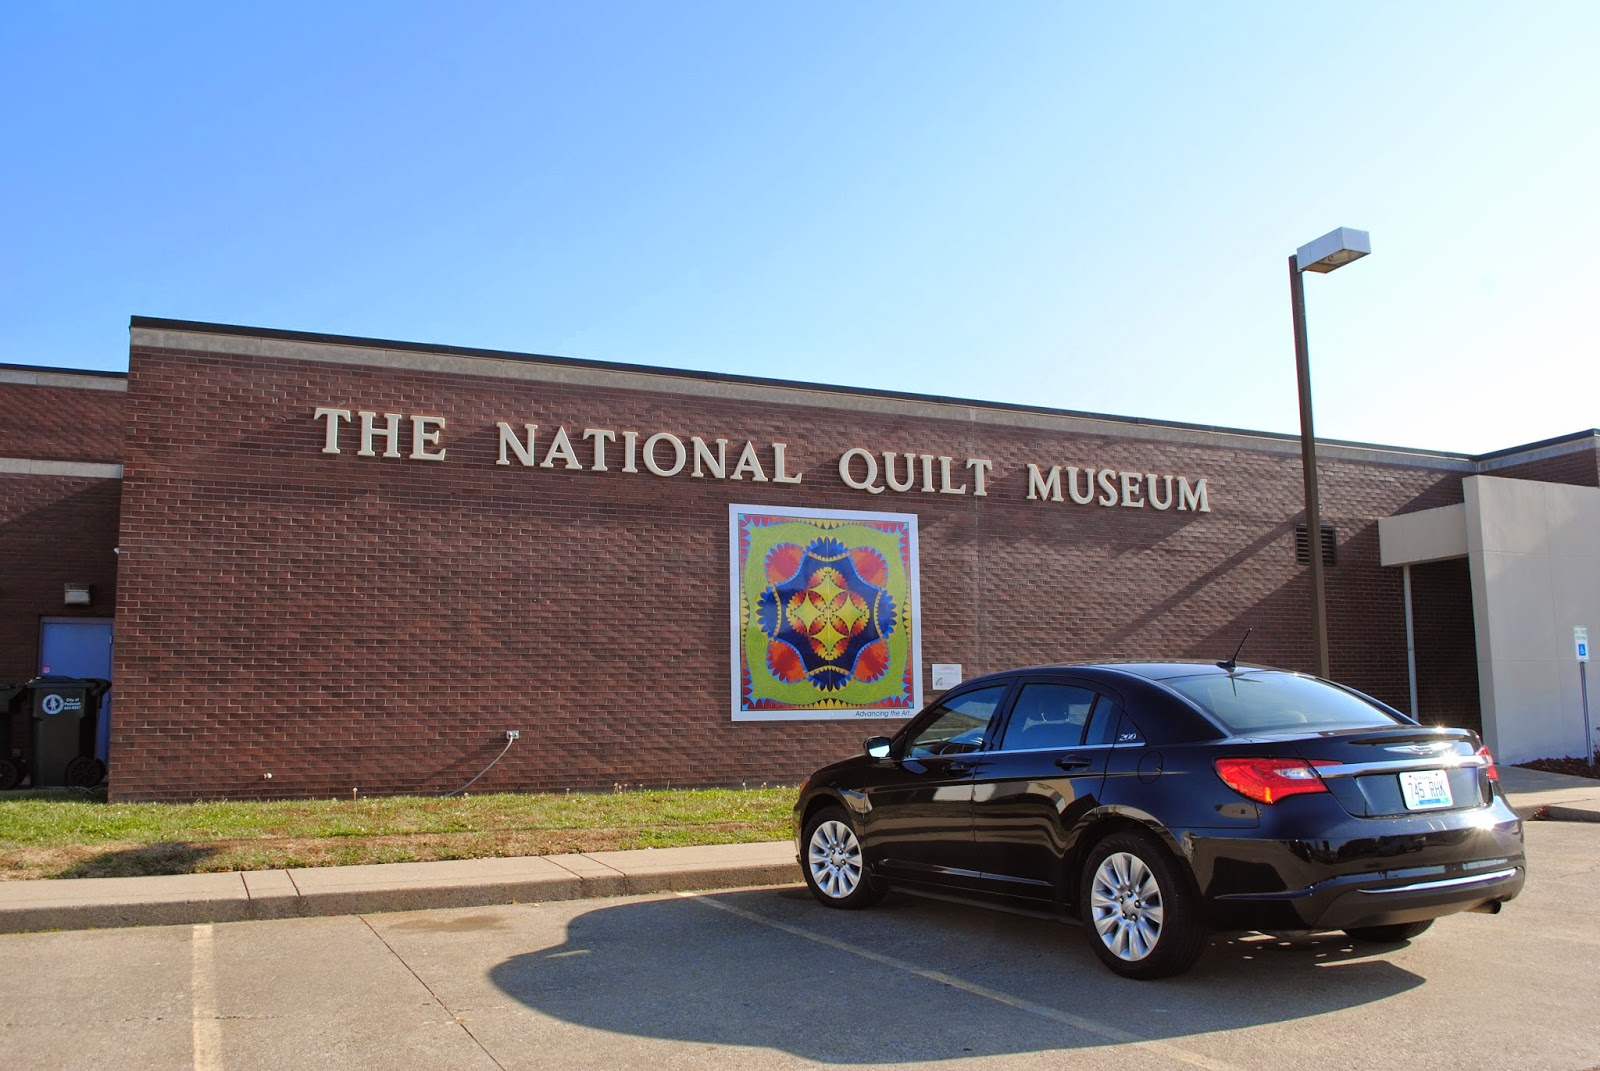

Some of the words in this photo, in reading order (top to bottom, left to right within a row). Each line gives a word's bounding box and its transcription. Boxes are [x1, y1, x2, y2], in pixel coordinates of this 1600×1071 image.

[314, 407, 447, 461] THE
[496, 421, 803, 484] NATIONAL
[838, 447, 993, 497] QUILT
[1026, 463, 1212, 513] MUSEUM
[1119, 733, 1137, 741] 200
[1408, 782, 1426, 800] 745
[1429, 780, 1447, 798] RHK
